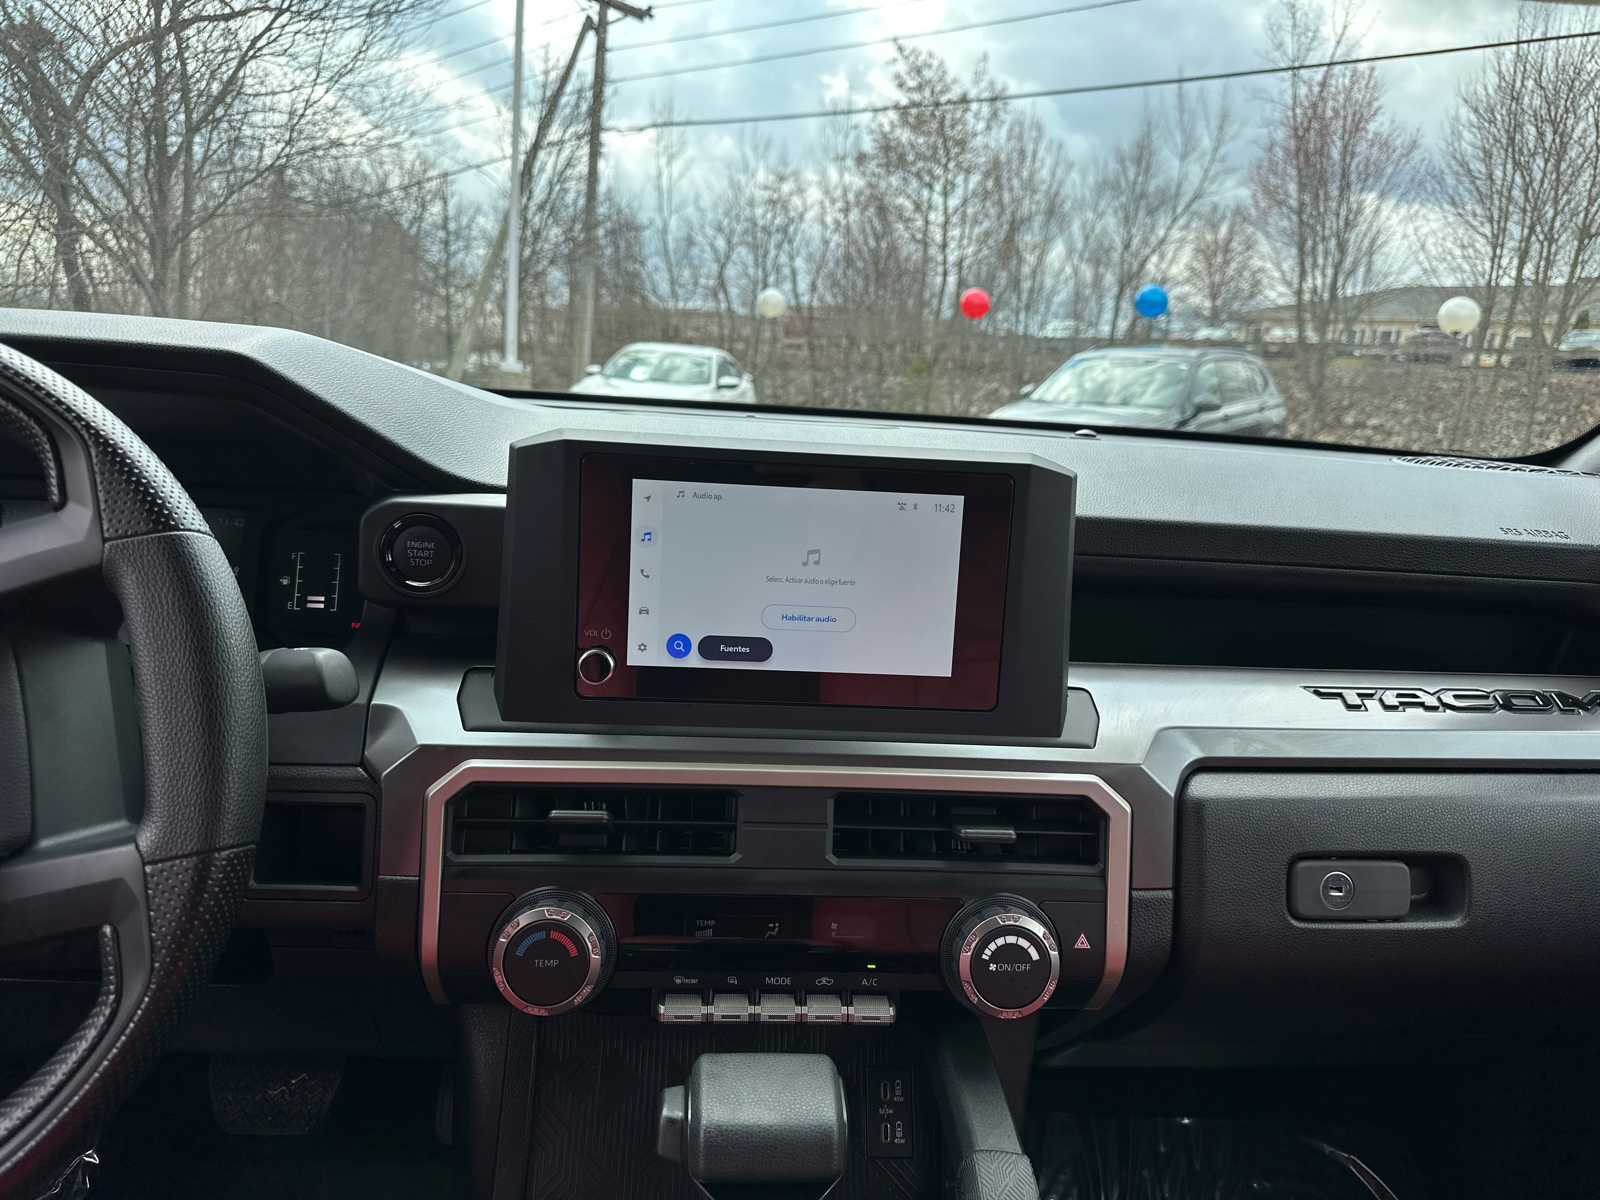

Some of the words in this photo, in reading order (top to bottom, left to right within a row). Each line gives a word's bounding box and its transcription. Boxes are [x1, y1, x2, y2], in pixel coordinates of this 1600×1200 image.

[692, 491, 713, 500] Audio
[713, 493, 724, 502] ap.
[934, 503, 956, 513] 11:42
[218, 518, 245, 527] 11:42
[1499, 527, 1523, 536] SRS
[1523, 528, 1571, 539] AIRBAG
[406, 540, 436, 549] ENGINE
[291, 552, 297, 560] F
[407, 549, 434, 558] START
[409, 558, 433, 567] STOP
[765, 575, 784, 584] Selecc.
[784, 576, 803, 584] Activar
[803, 577, 819, 585] audio
[824, 578, 838, 587] elige
[838, 578, 856, 587] fuente
[287, 602, 293, 610] E
[781, 613, 815, 622] Habilitar
[815, 615, 837, 623] audio
[584, 629, 599, 637] VOL
[720, 644, 750, 653] Fuentes
[696, 919, 716, 927] TEMP
[534, 959, 559, 968] TEMP
[997, 963, 1031, 972] ON/OFF
[765, 976, 792, 985] MODE
[861, 977, 878, 987] A/C
